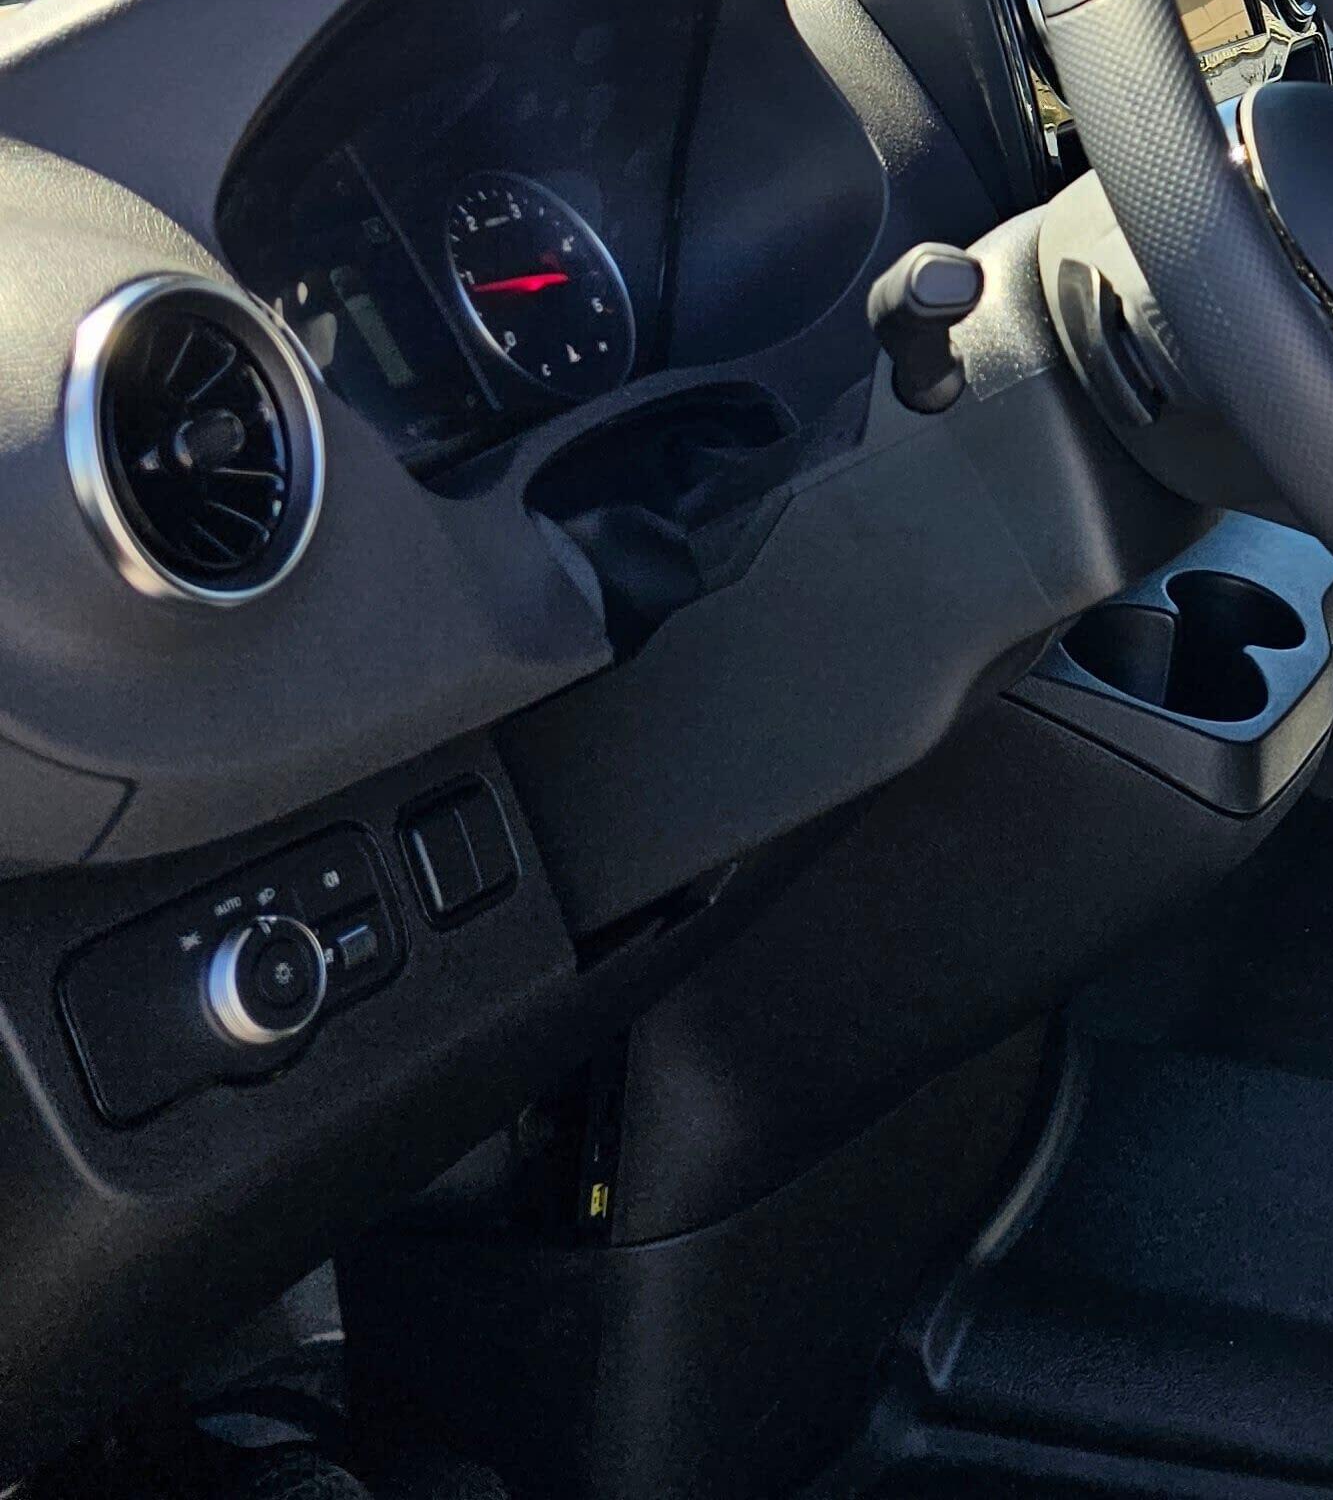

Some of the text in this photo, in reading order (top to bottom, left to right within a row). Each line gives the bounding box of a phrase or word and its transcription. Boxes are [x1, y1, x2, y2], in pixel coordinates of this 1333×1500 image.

[466, 215, 478, 232] 2
[504, 331, 517, 347] 0
[214, 896, 242, 917] AUTO
